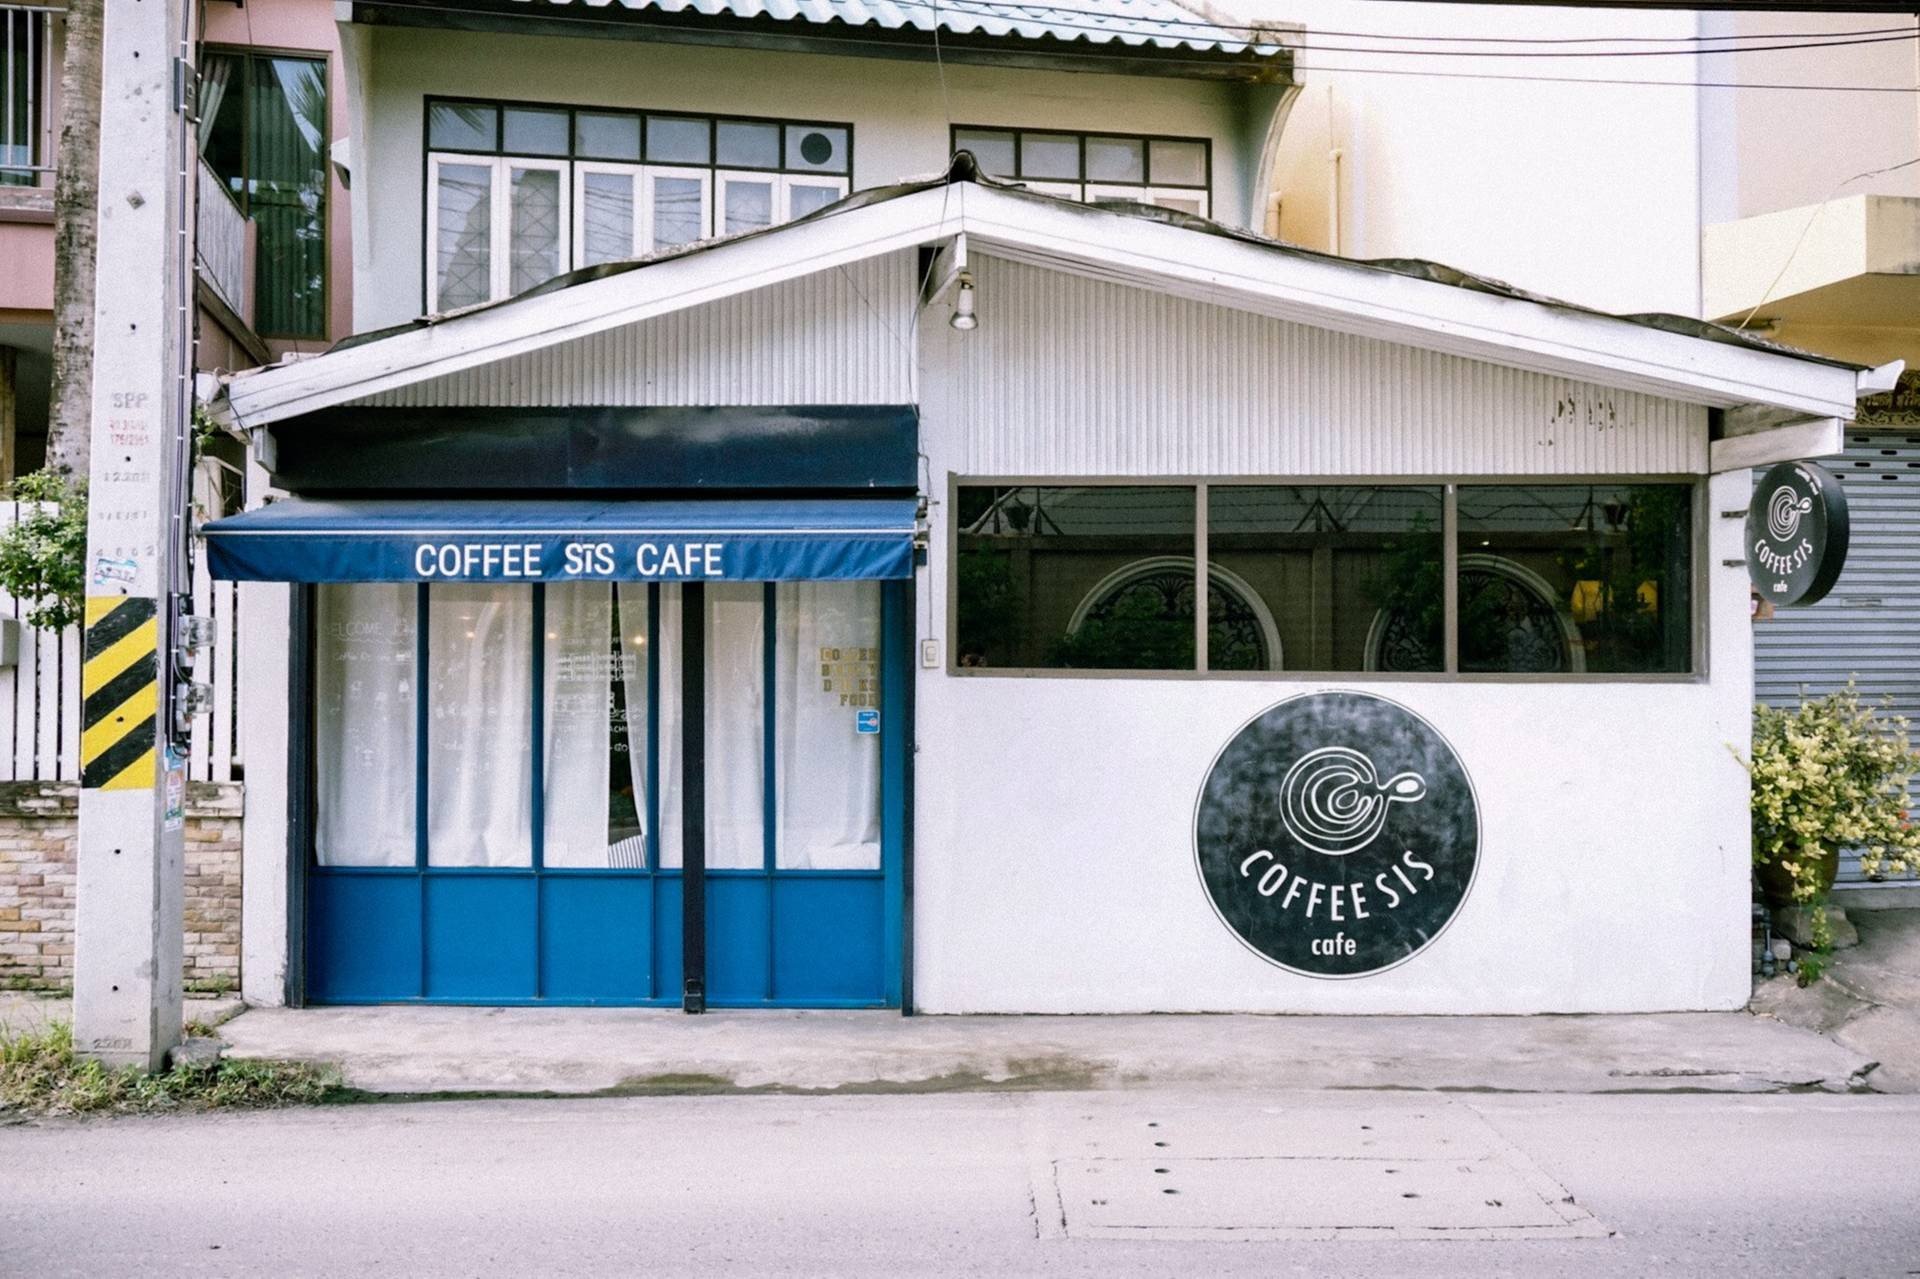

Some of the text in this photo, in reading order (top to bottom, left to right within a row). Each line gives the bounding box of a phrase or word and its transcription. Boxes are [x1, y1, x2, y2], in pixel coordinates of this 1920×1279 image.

[414, 543, 543, 577] COFFEE
[636, 543, 724, 576] CAFE
[1755, 538, 1813, 575] COFFEE SIS
[1773, 580, 1788, 592] cafe
[1240, 850, 1434, 921] COFFEE SIS
[1311, 931, 1357, 955] cafe
